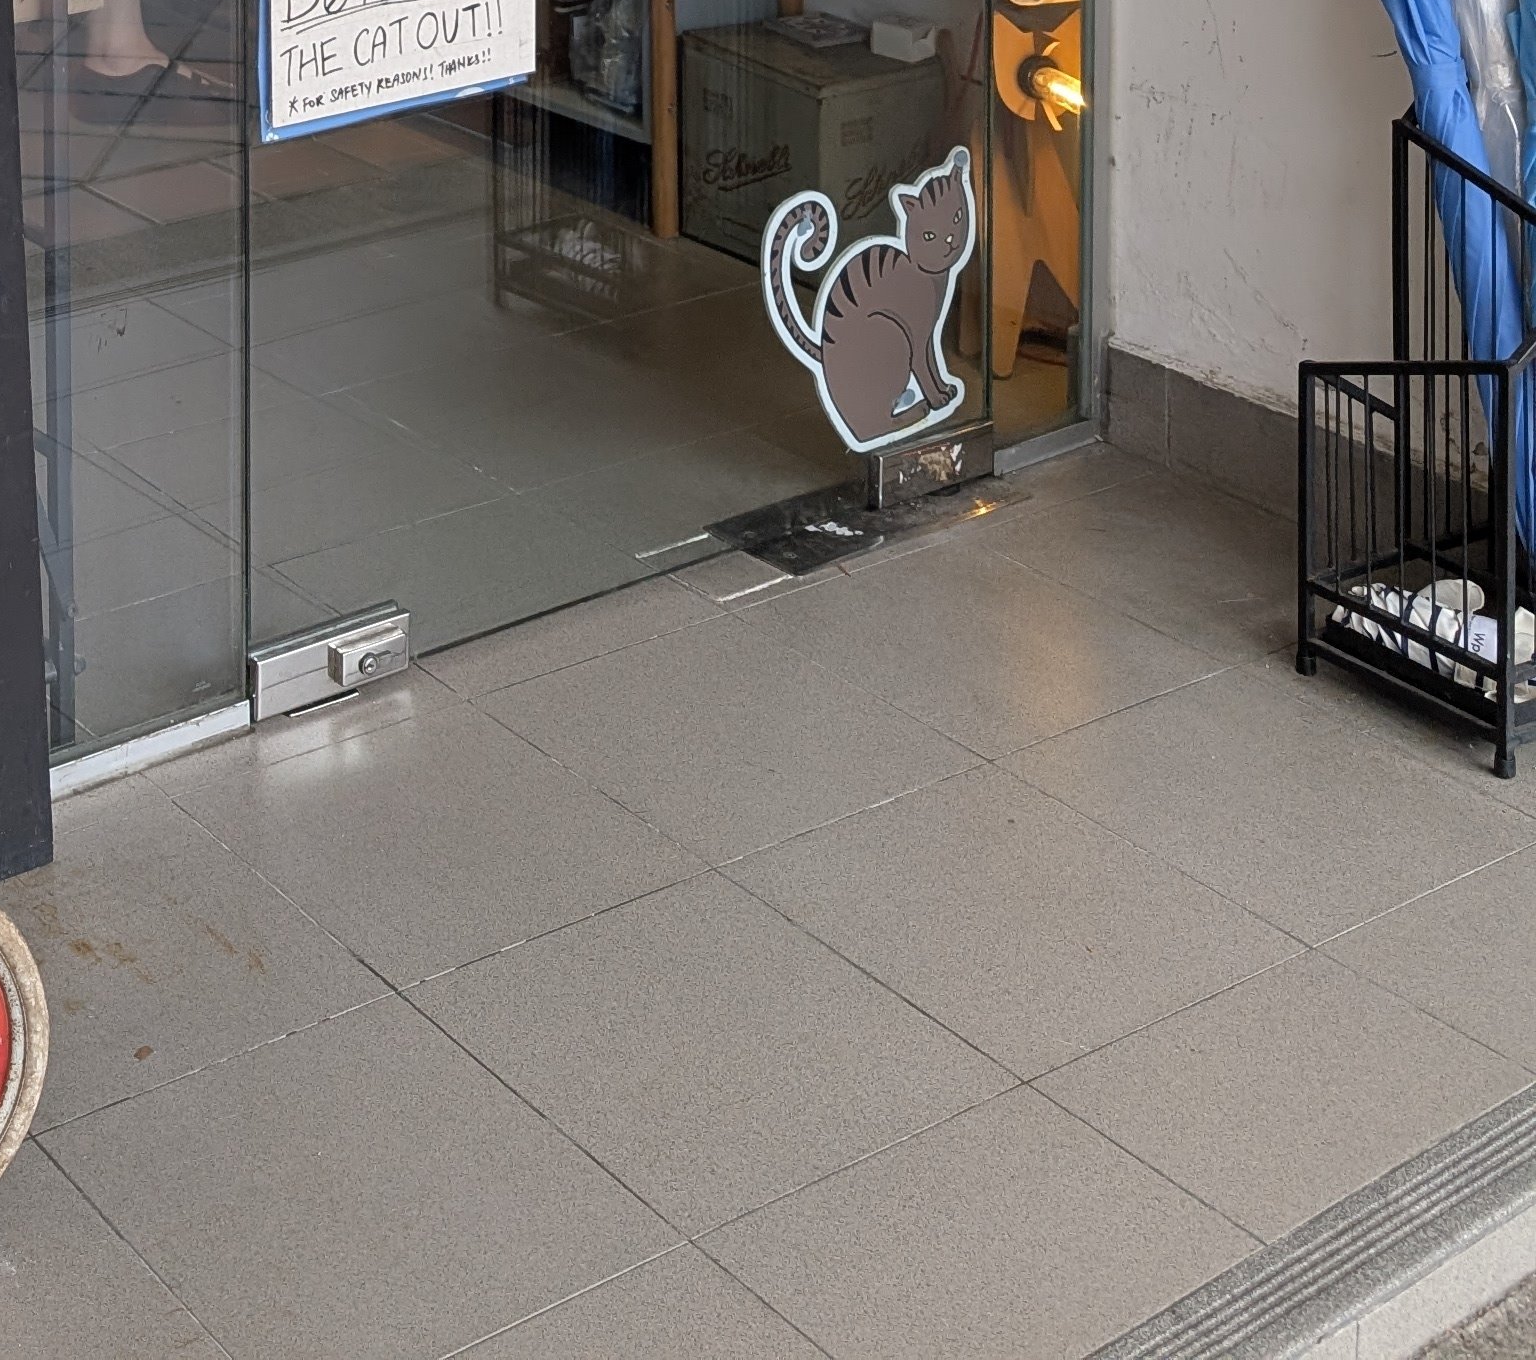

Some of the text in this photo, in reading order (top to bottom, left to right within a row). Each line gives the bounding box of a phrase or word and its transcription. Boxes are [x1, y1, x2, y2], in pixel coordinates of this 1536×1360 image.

[279, 36, 344, 87] THE
[353, 15, 409, 67] CAT
[302, 47, 492, 113] FOR SAFETY REASONS! THANKS!!
